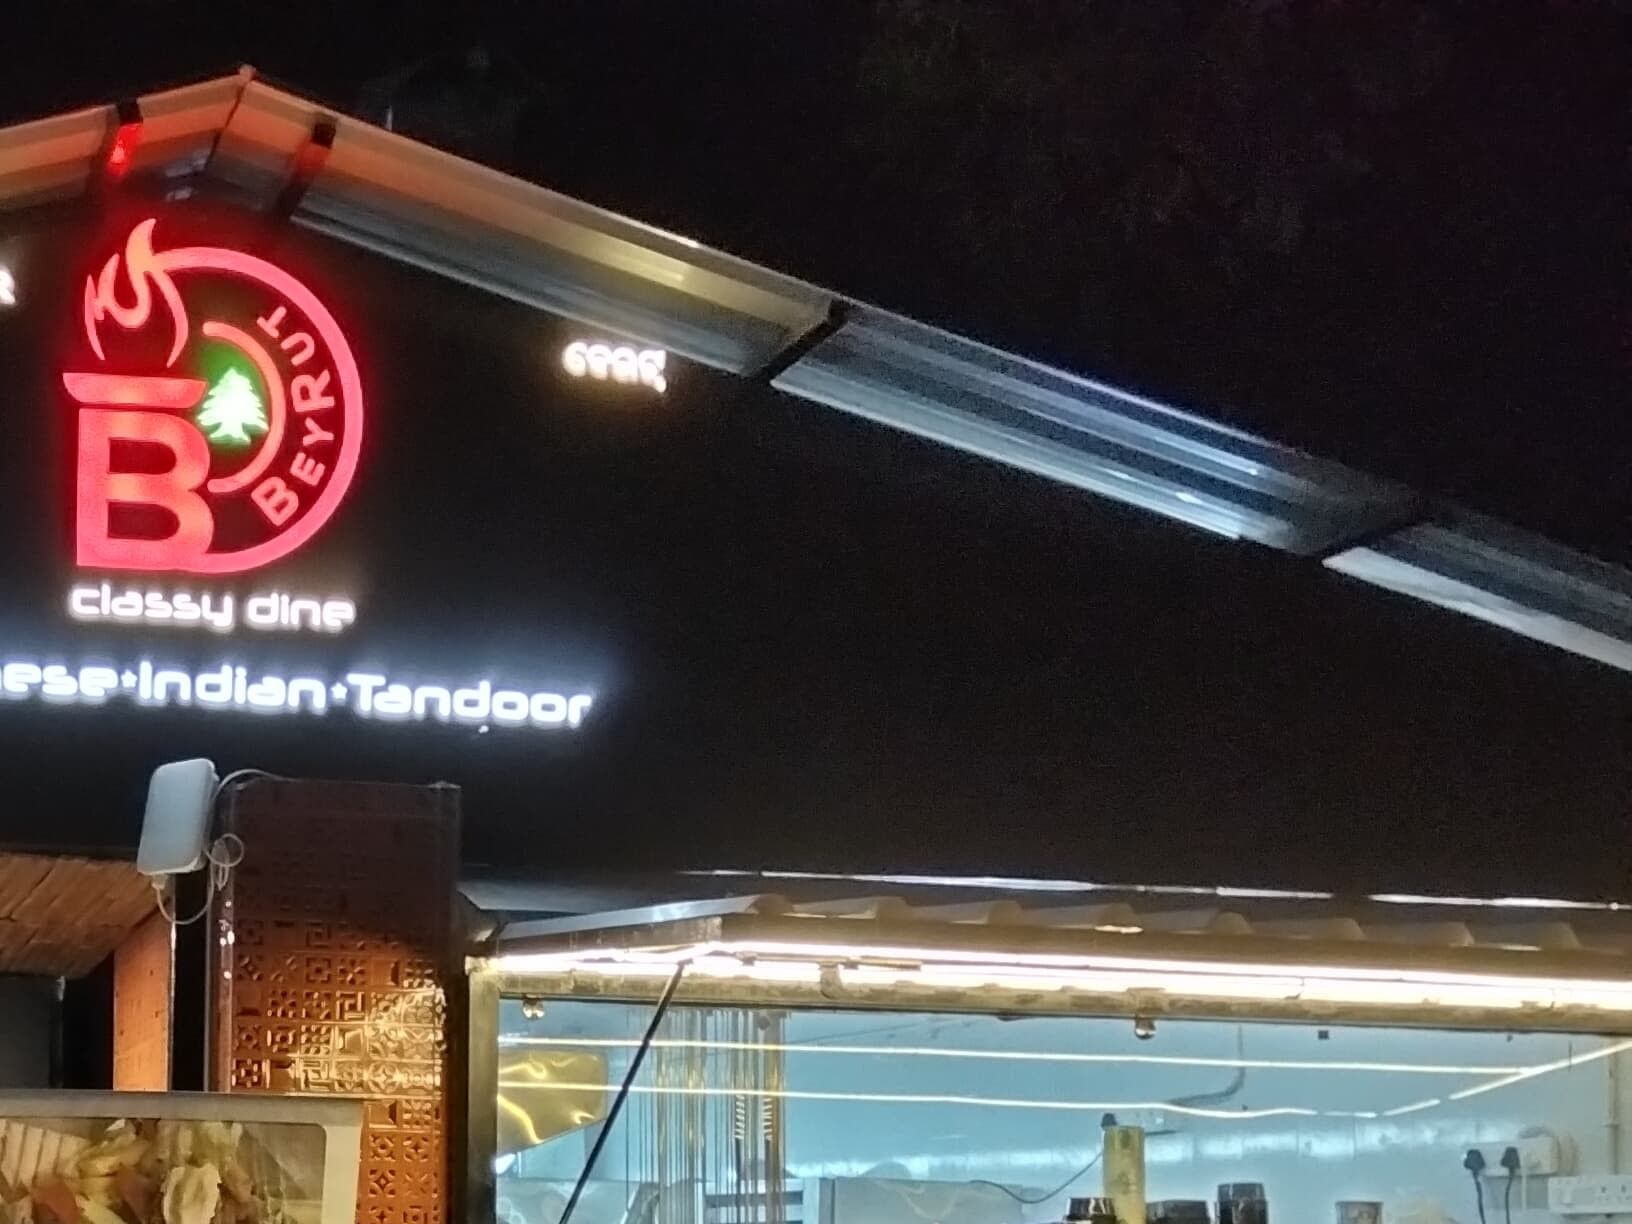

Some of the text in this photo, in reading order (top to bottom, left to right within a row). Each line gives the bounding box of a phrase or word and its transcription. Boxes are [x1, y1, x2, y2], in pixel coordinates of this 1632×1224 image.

[251, 304, 338, 529] BEYRUT
[70, 583, 355, 628] classy dine
[138, 656, 327, 714] Indian
[345, 670, 595, 728] Tandoor
